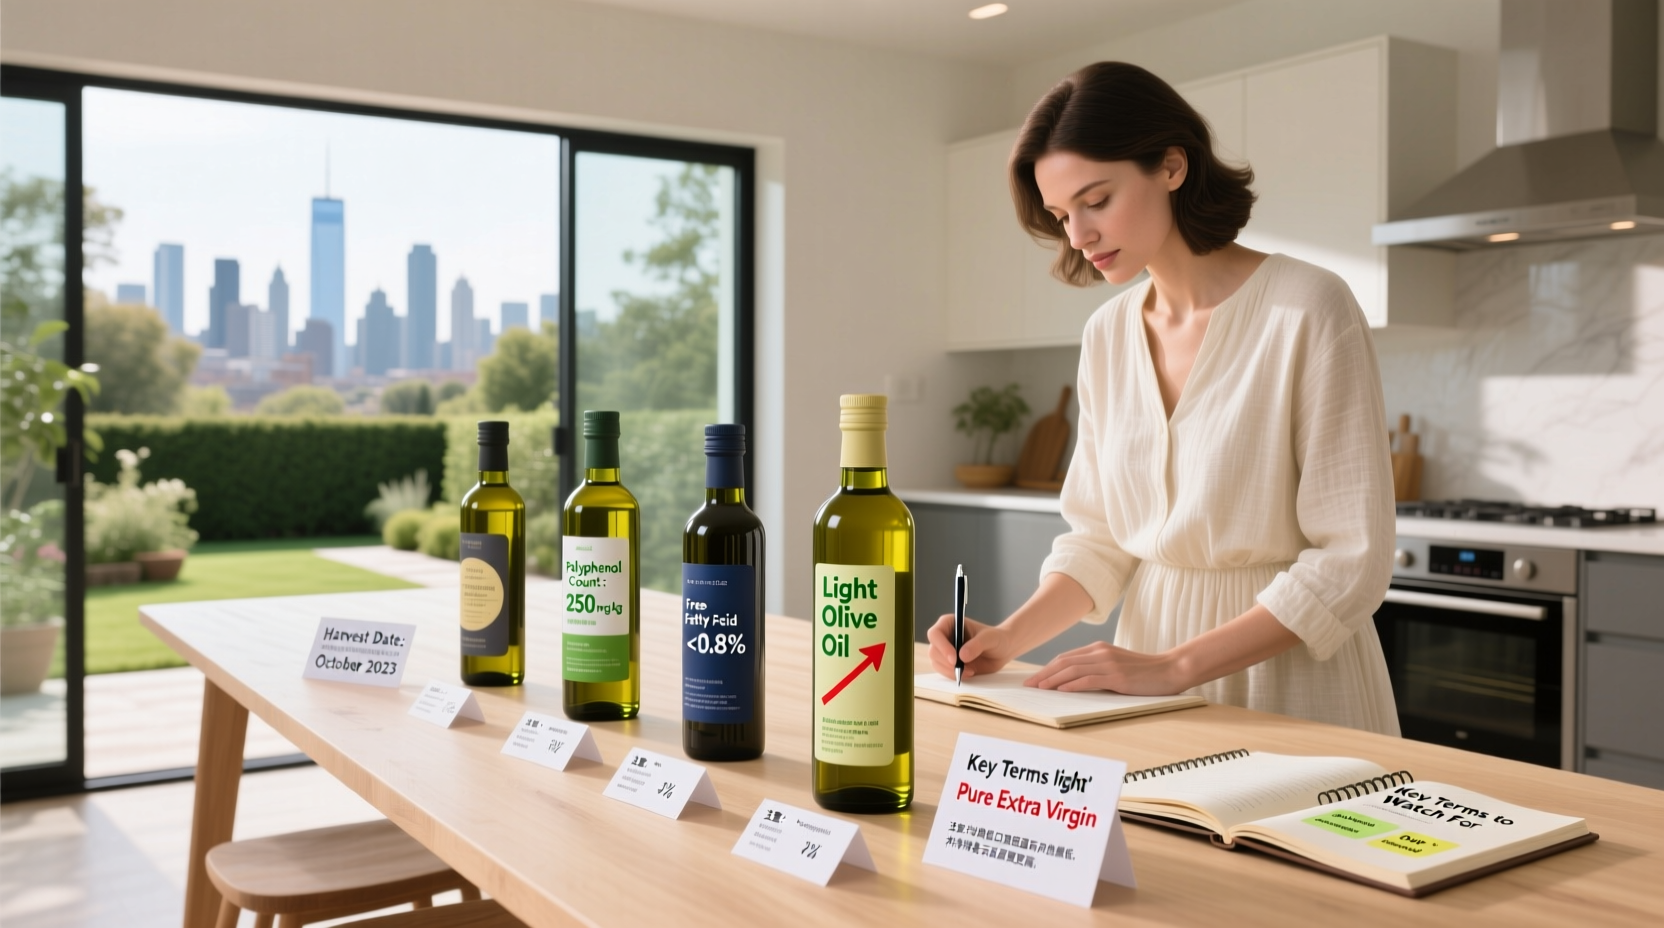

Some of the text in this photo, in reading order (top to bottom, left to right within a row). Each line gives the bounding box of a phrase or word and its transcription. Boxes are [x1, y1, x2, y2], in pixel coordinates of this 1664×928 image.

[823, 576, 878, 604] Light
[566, 593, 596, 614] 250
[821, 604, 878, 629] Olive
[323, 627, 406, 648] Harvest Date:
[686, 632, 747, 655] <0.8%
[821, 633, 850, 658] Oil
[315, 653, 398, 676] October 2023
[967, 753, 998, 780] Key
[1002, 759, 1050, 785] Terms
[956, 782, 1098, 831] Pure Extra Virgin
[1382, 795, 1483, 829] Watch For
[1394, 786, 1515, 826] Key Terms to
